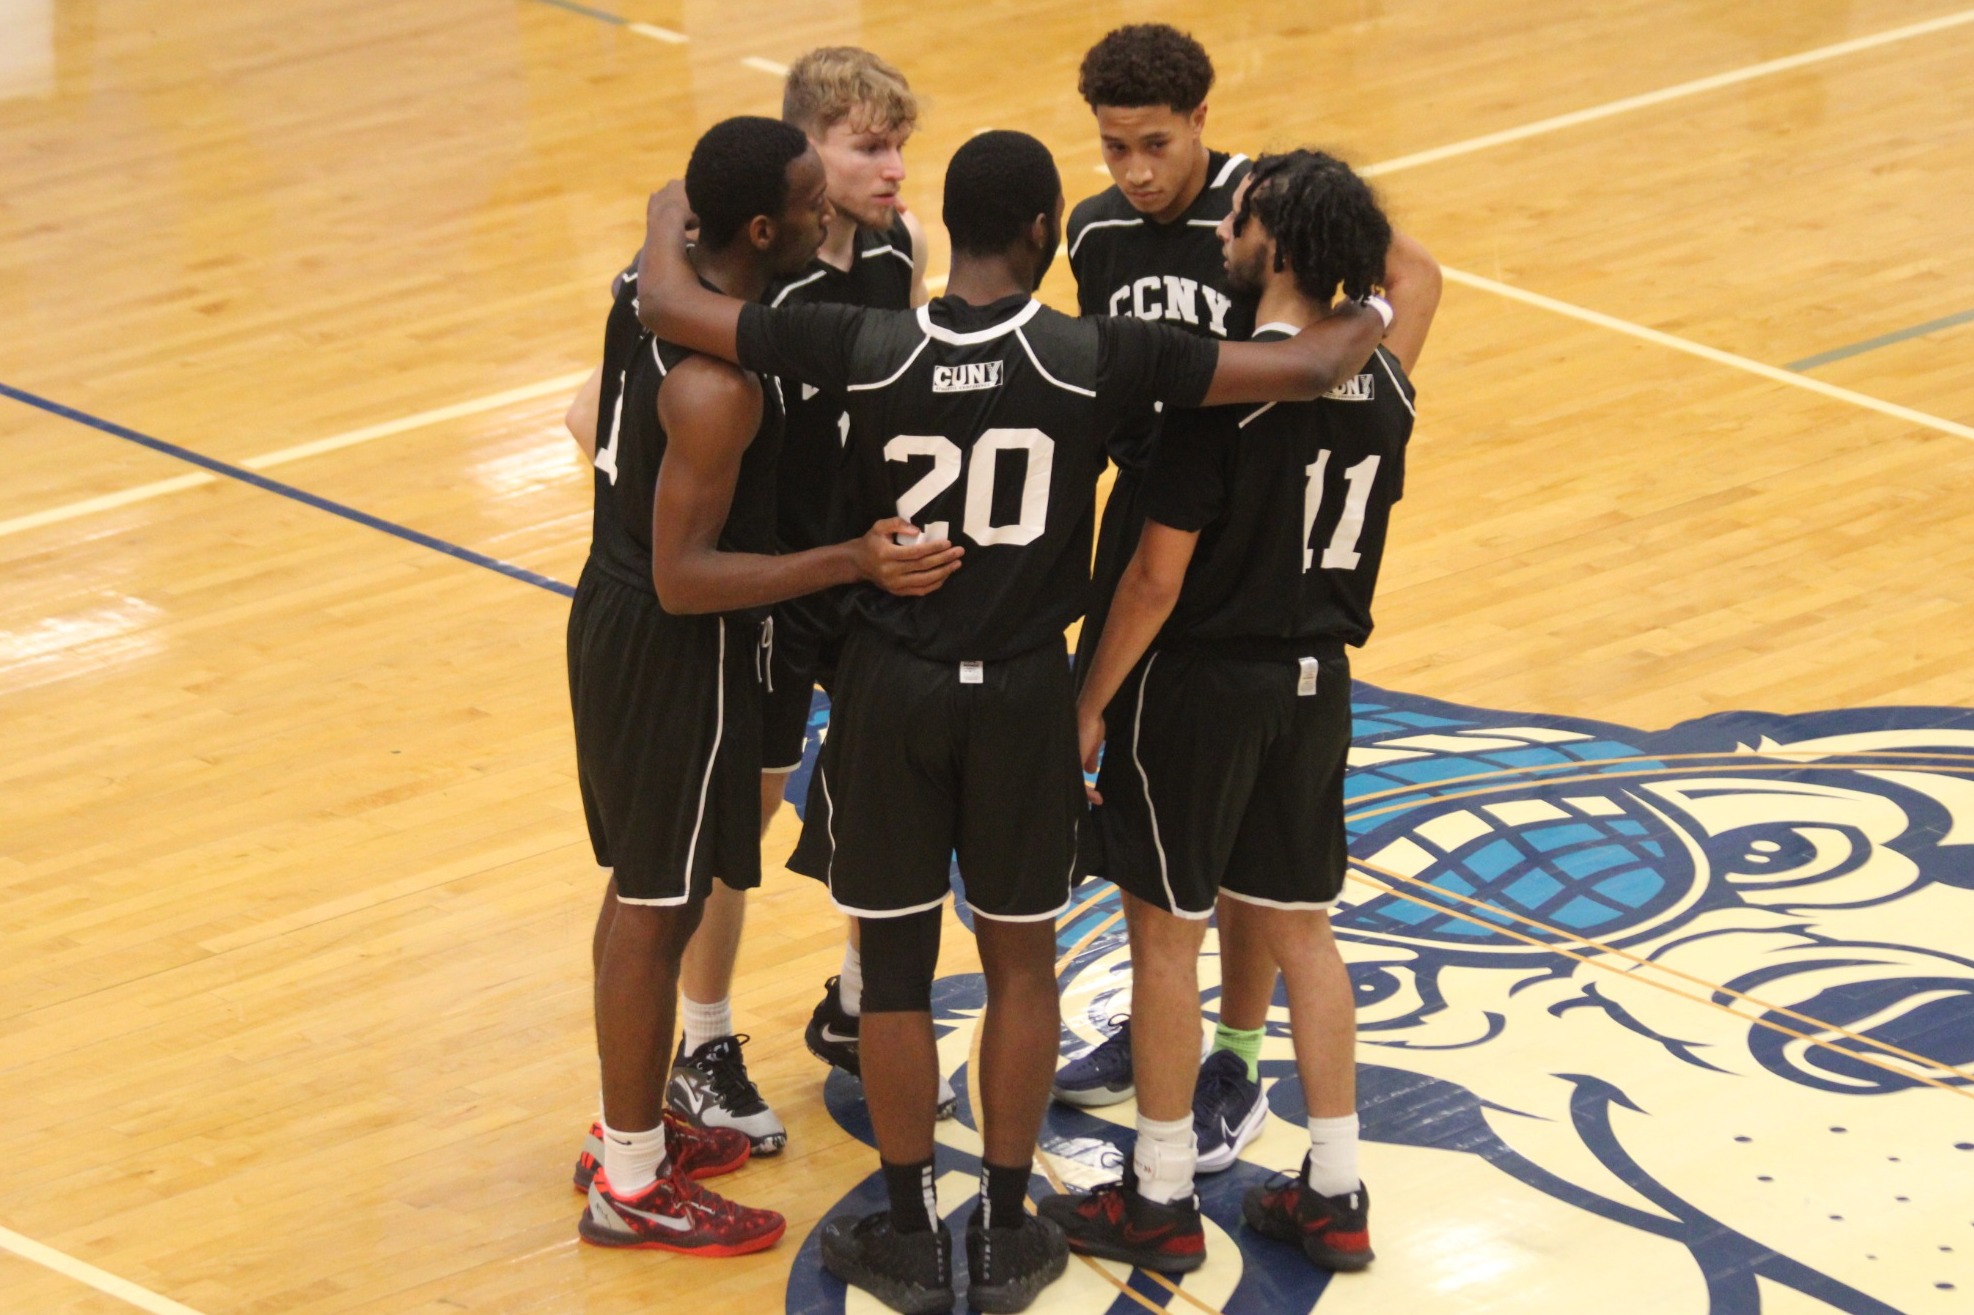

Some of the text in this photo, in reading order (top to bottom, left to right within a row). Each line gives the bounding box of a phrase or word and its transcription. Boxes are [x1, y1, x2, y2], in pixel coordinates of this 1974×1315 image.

[1109, 275, 1232, 337] CCNY
[934, 361, 1001, 387] CUNY
[883, 427, 1055, 547] 20
[1302, 448, 1381, 574] 11
